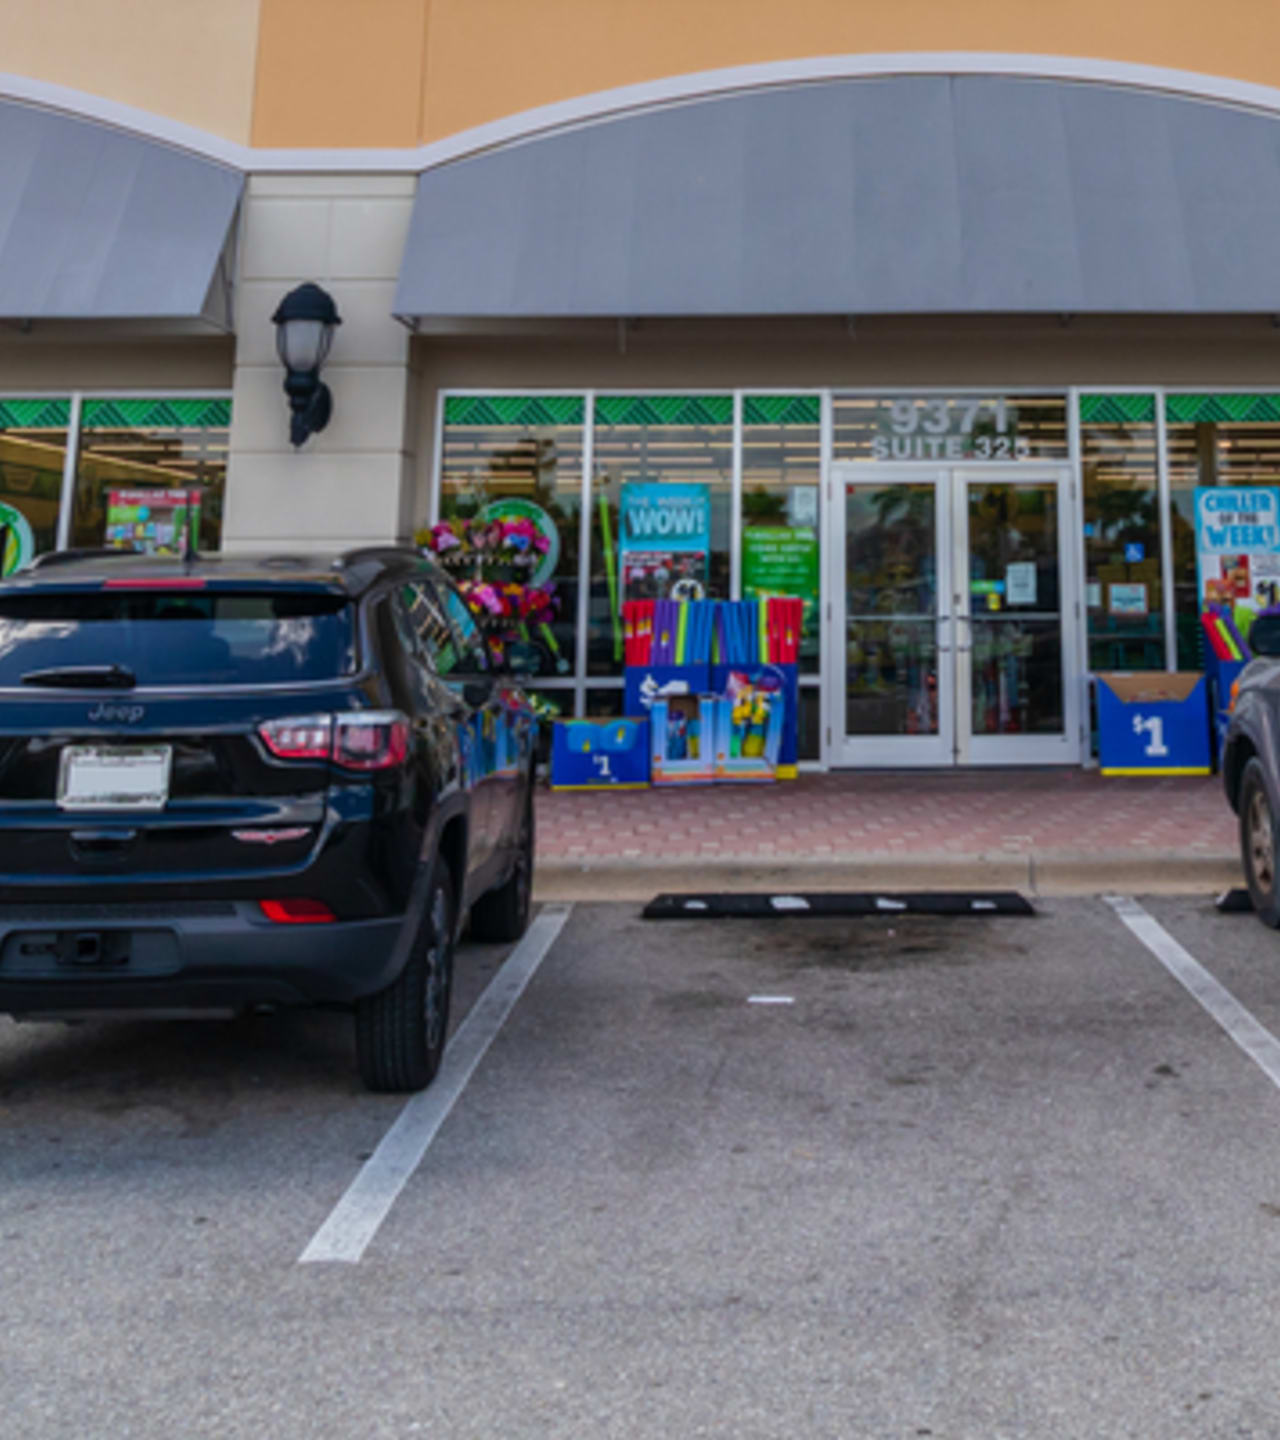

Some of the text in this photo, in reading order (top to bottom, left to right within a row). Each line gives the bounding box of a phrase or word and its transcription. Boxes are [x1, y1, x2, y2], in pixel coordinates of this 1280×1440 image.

[890, 397, 1008, 434] 9371
[871, 435, 963, 459] SUITE
[627, 508, 705, 535] WOW!
[87, 701, 145, 723] Jeep
[1132, 713, 1170, 758] $1
